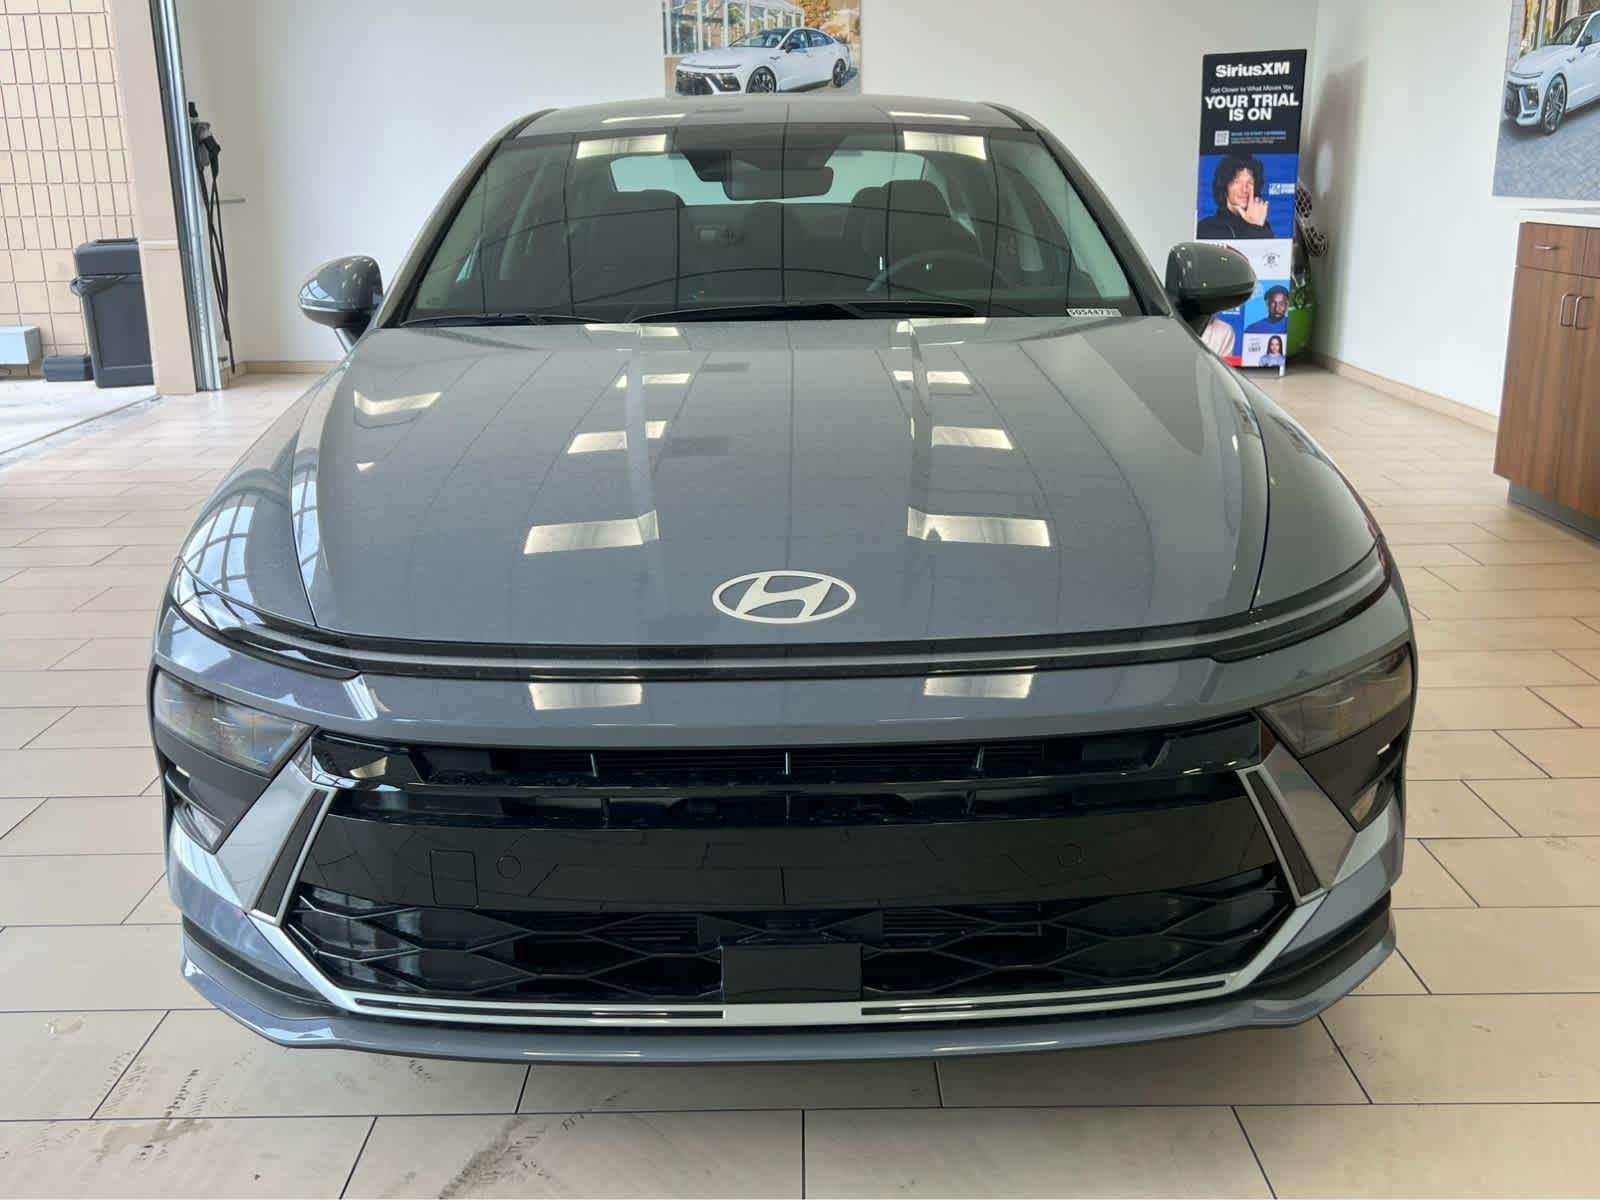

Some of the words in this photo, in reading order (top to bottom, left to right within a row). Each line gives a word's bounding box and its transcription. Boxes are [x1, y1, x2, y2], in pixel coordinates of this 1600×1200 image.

[1215, 61, 1290, 78] SiriusXM
[1204, 94, 1249, 109] YOUR
[1251, 92, 1299, 107] TRIAL
[1228, 108, 1244, 121] IS
[1247, 107, 1272, 120] ON
